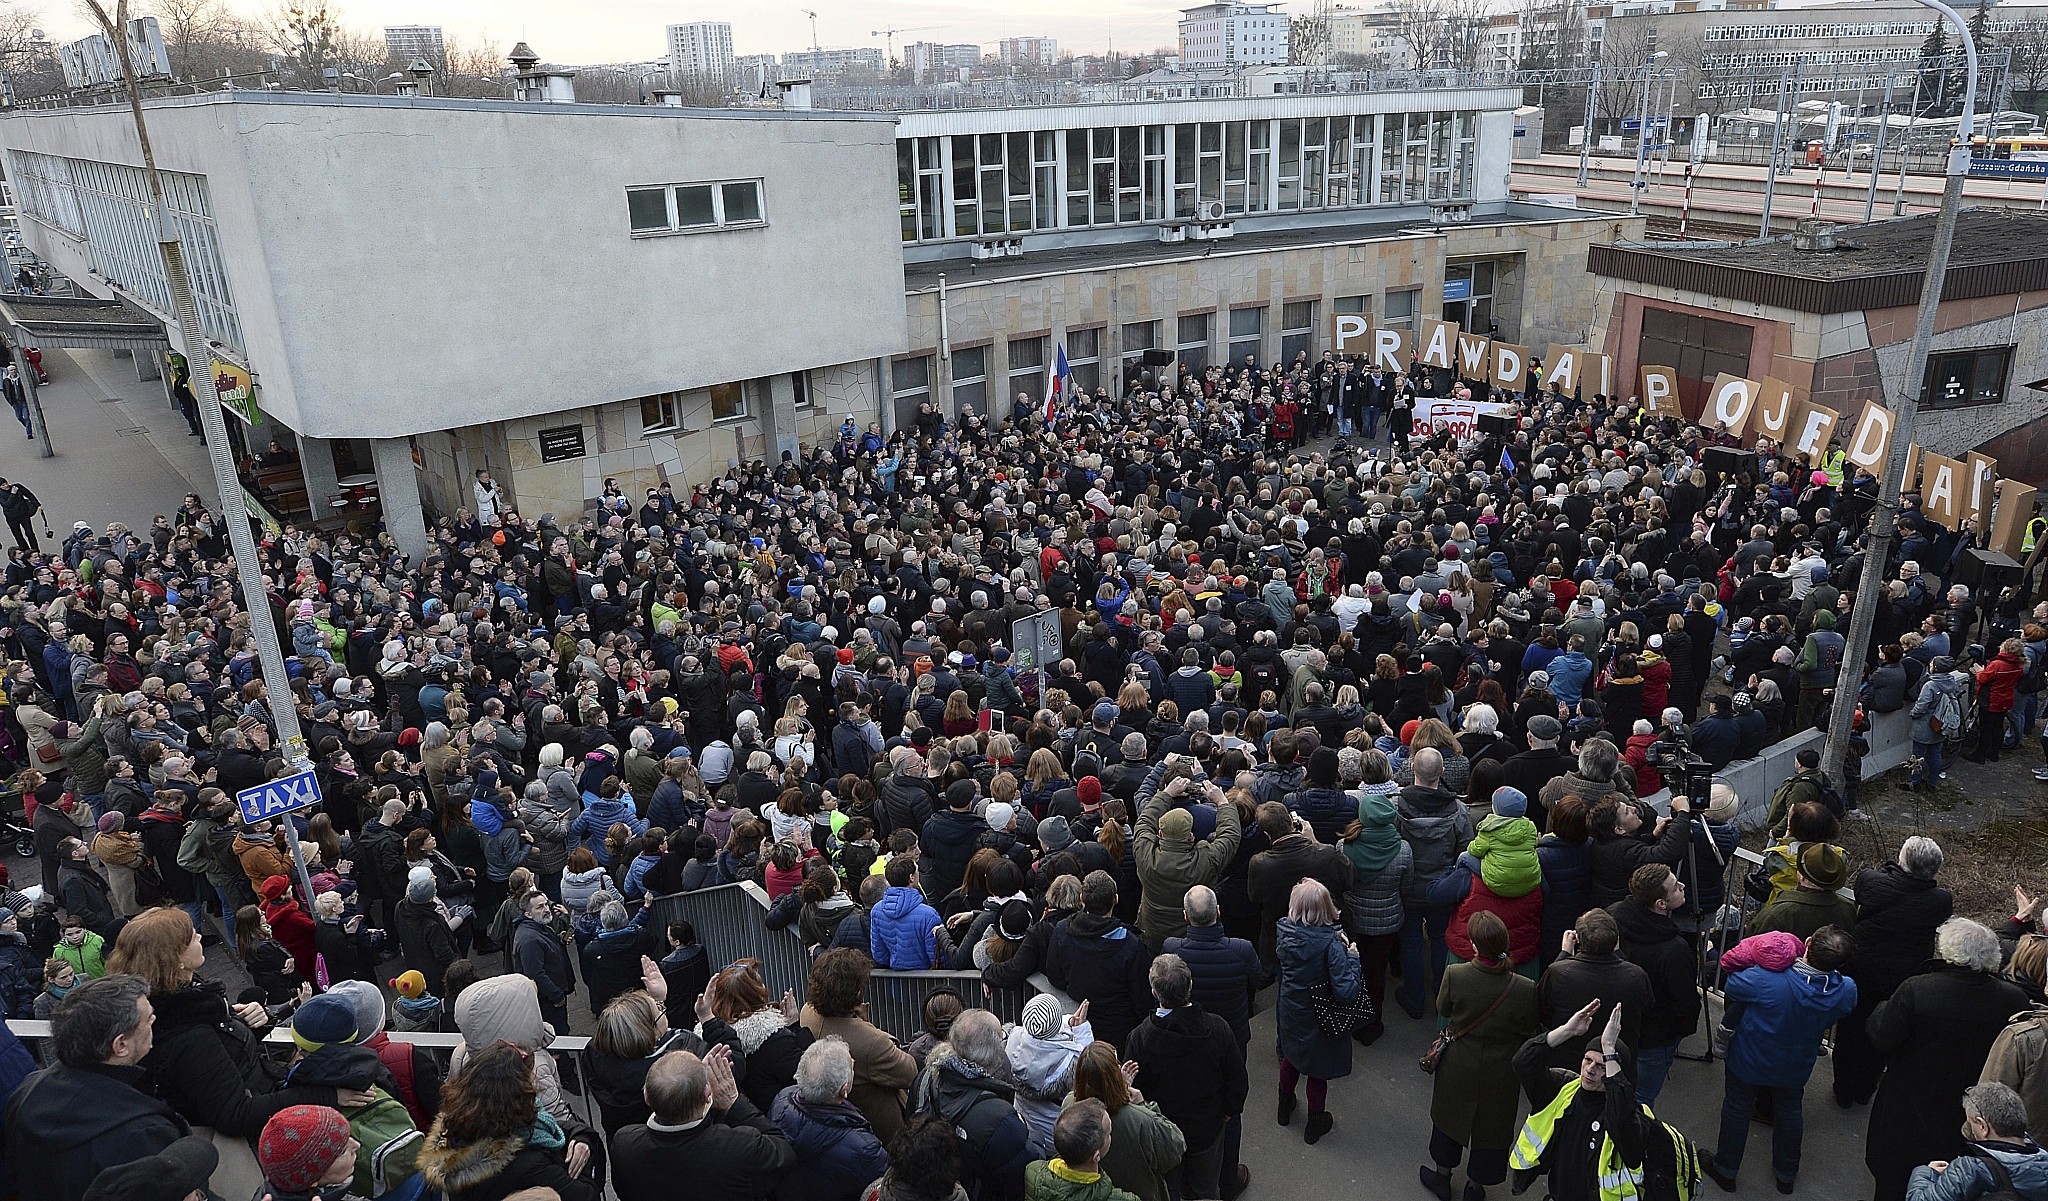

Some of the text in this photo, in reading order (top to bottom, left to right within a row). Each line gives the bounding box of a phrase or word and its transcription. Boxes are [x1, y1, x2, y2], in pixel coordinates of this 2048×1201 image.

[2008, 163, 2046, 173] Gdańska
[1336, 315, 1574, 389] PRAWDA
[220, 385, 246, 400] KEBAB
[241, 777, 316, 816] TAXI
